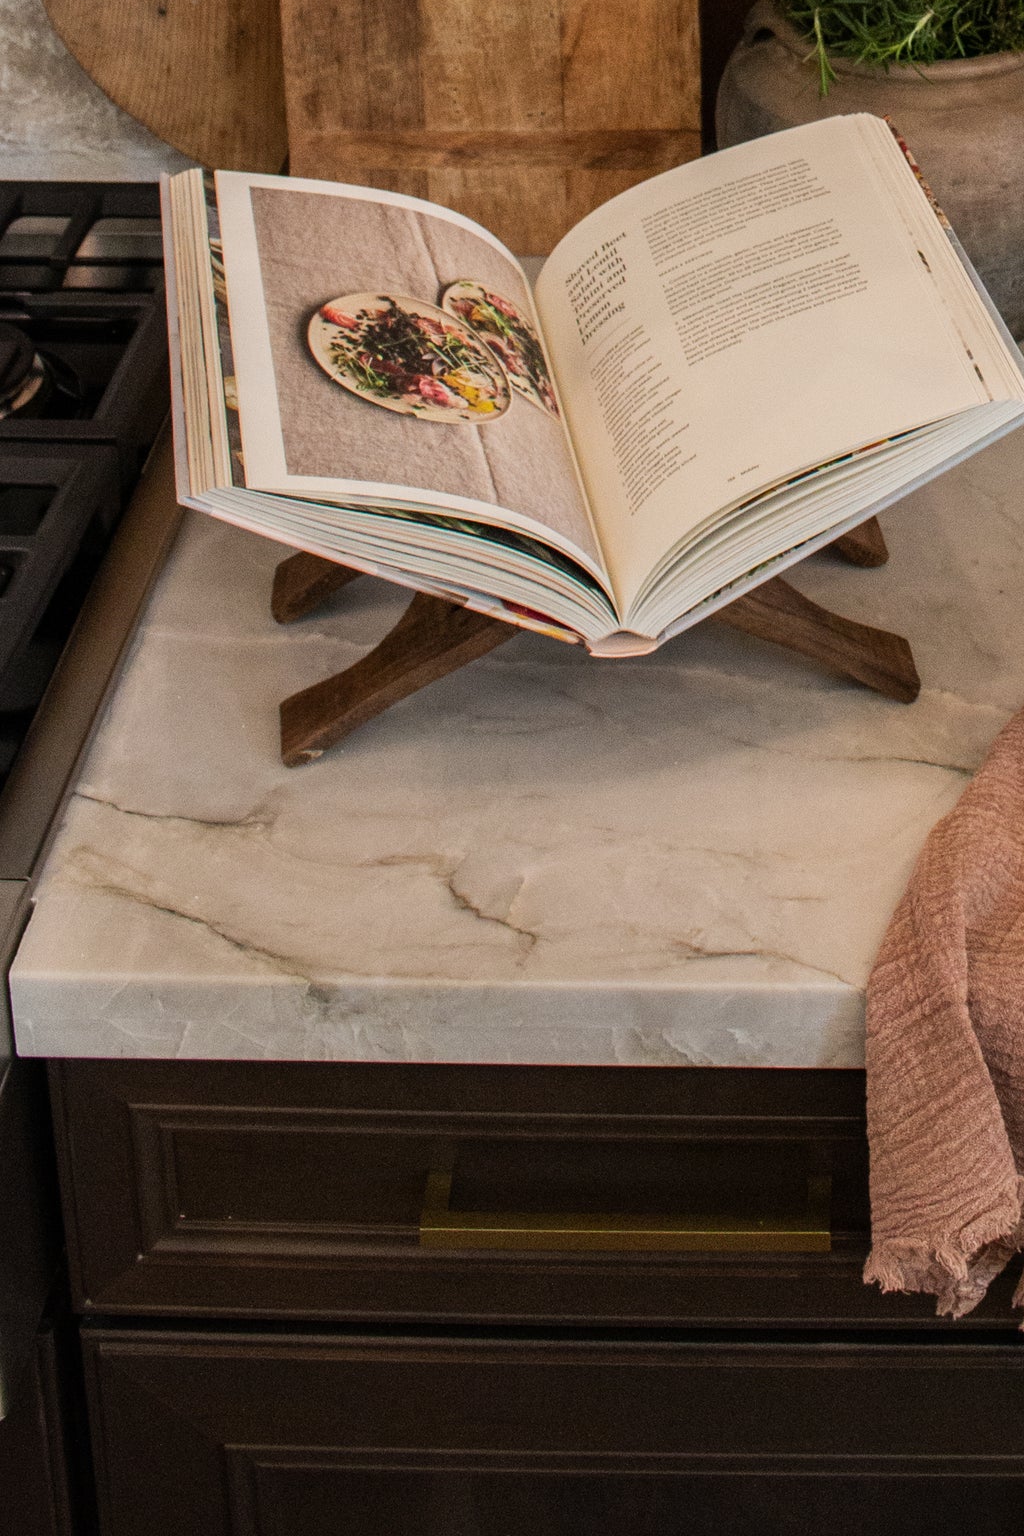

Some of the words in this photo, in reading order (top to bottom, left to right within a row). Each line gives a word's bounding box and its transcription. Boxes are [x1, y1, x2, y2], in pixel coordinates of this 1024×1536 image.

[565, 250, 599, 288] Shaved
[601, 231, 627, 252] Beet
[567, 274, 585, 298] and
[586, 247, 618, 276] Lentil
[570, 276, 596, 303] Salad
[598, 257, 623, 277] with
[606, 264, 628, 283] and
[575, 276, 627, 325] Preserved
[578, 301, 611, 336] Lemon
[581, 301, 626, 346] Dressing
